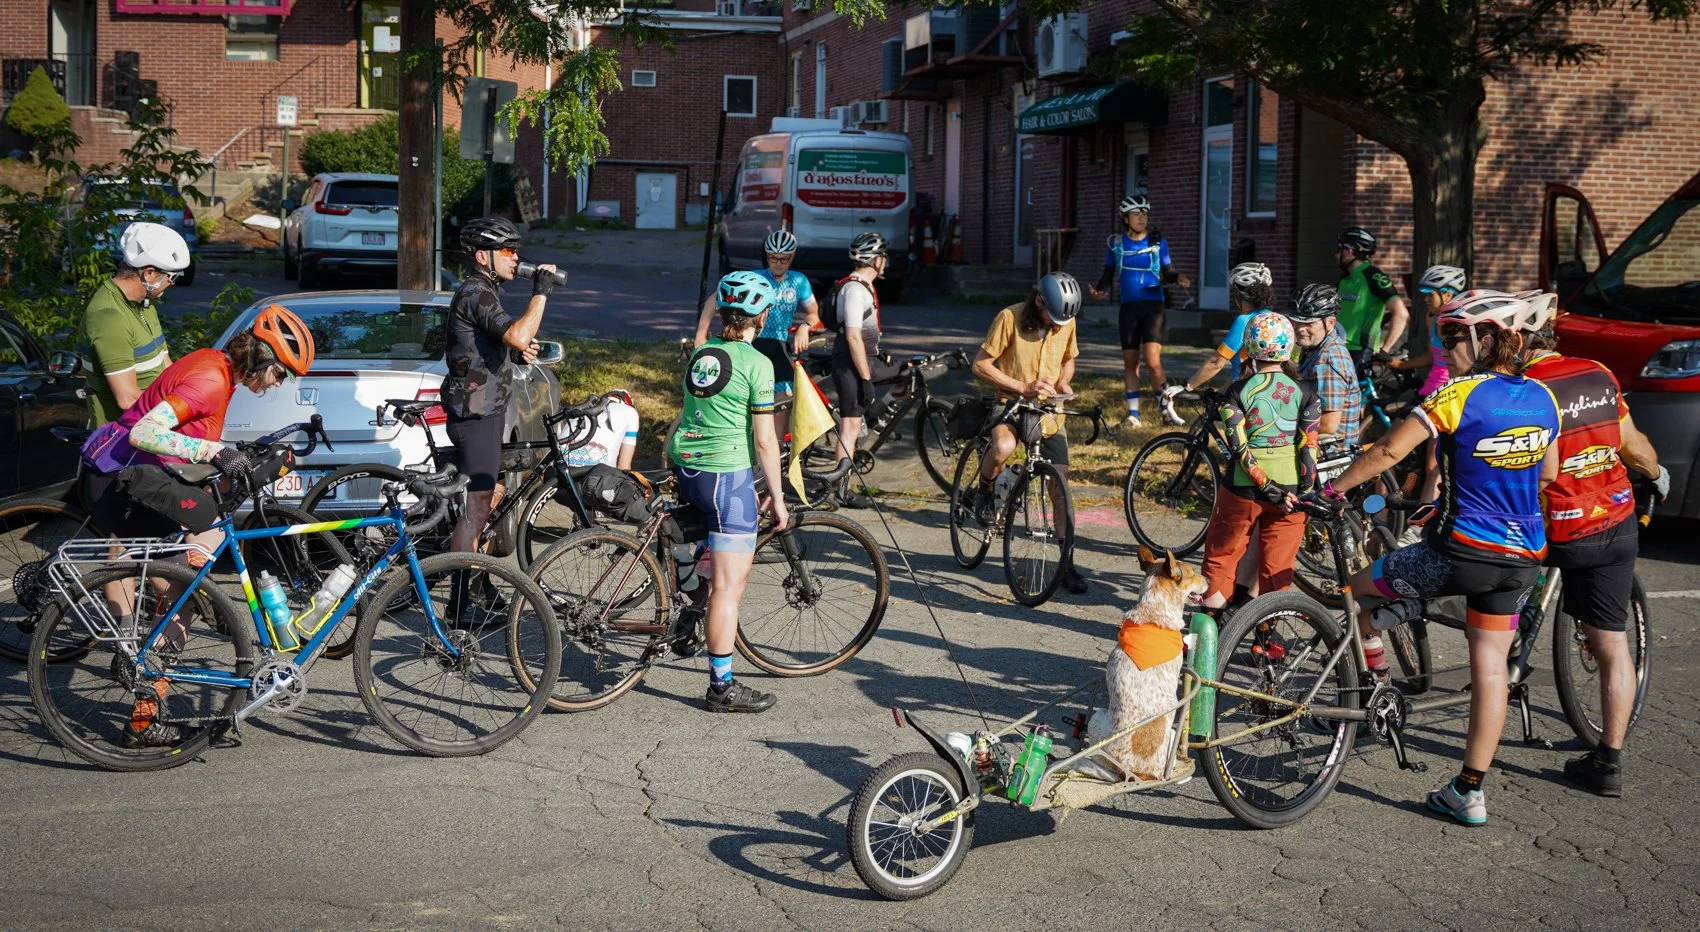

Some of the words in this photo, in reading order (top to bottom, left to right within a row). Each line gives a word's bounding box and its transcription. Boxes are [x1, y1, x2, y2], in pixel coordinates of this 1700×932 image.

[1022, 116, 1038, 130] HAIR
[1039, 115, 1045, 127] &
[1047, 111, 1070, 126] COLOR
[1071, 105, 1096, 122] SALON
[1560, 388, 1616, 418] ngelina's
[1473, 427, 1553, 457] S&W
[1490, 453, 1544, 468] SPORTS
[1561, 446, 1617, 473] S&W
[1574, 463, 1615, 479] SPORTS
[276, 475, 302, 491] 23D
[327, 471, 370, 490] BOYD
[529, 487, 558, 526] BOYD
